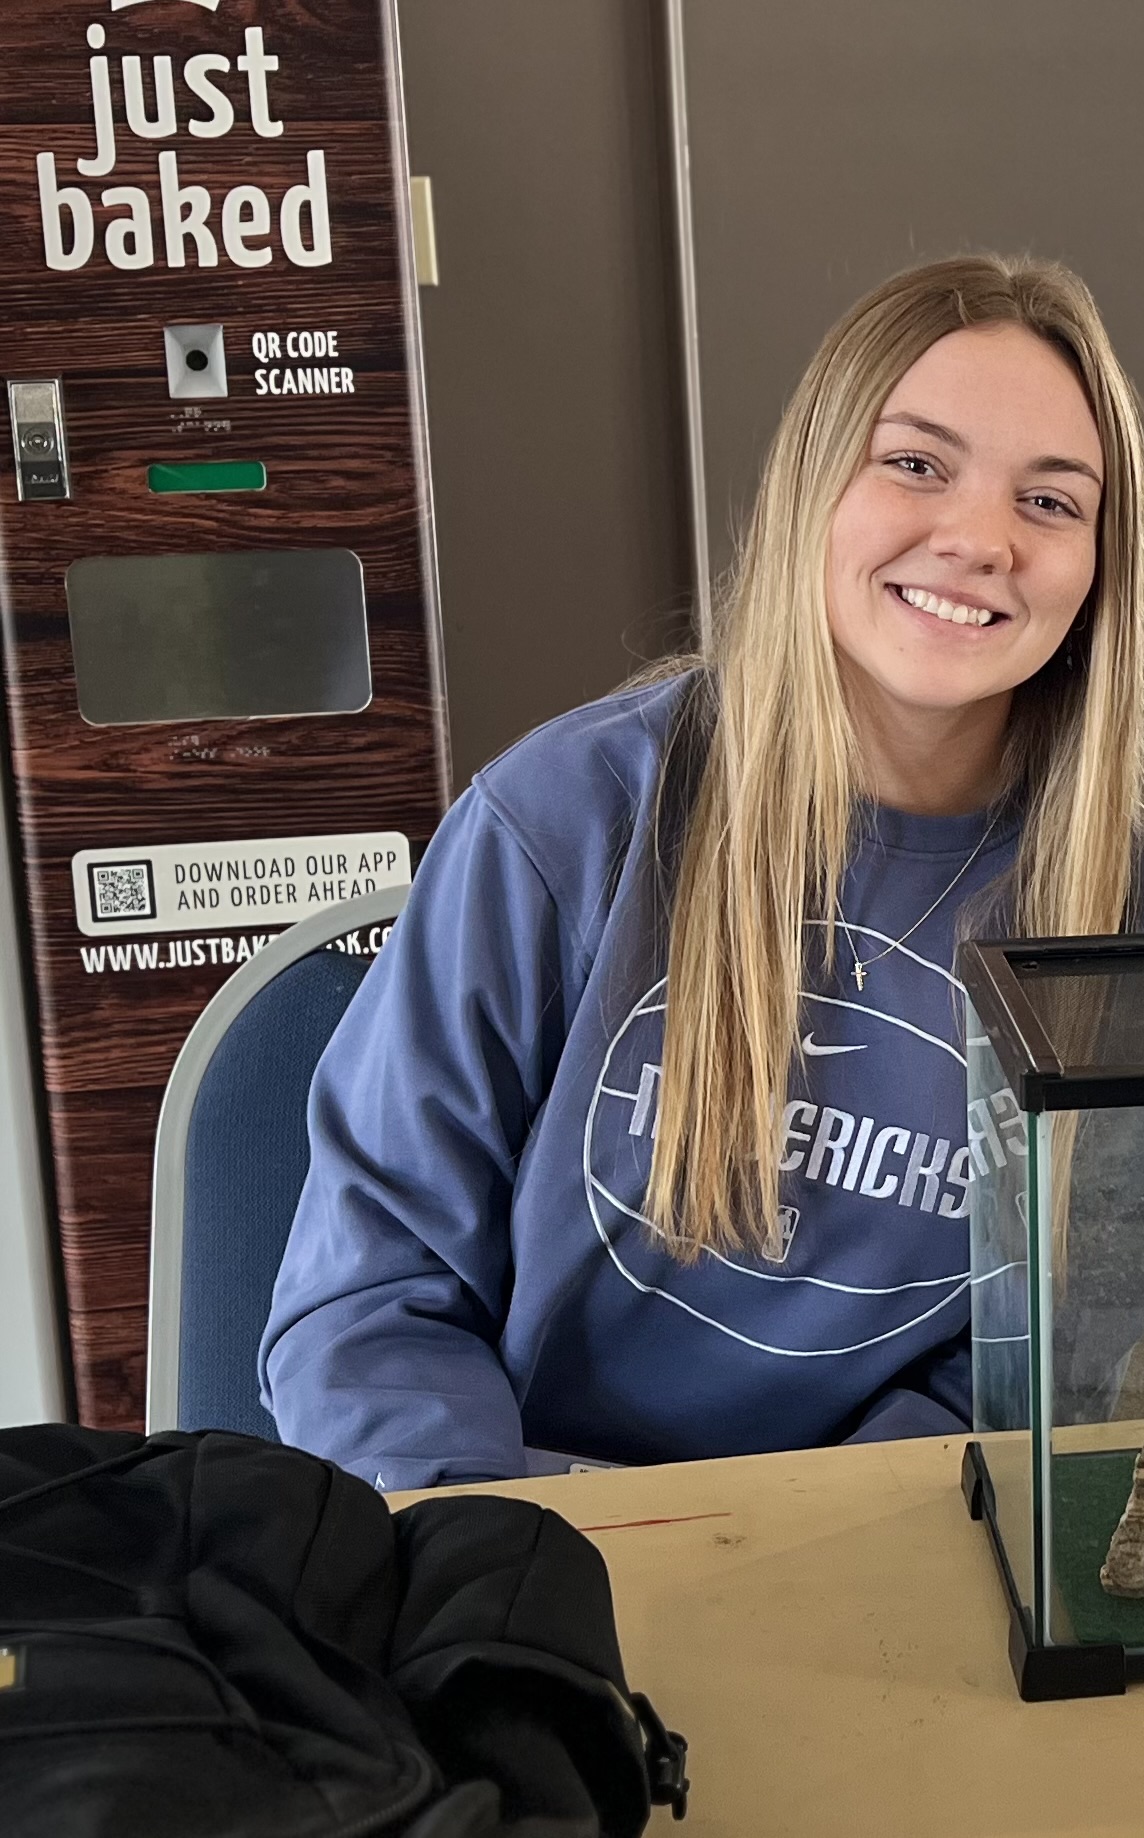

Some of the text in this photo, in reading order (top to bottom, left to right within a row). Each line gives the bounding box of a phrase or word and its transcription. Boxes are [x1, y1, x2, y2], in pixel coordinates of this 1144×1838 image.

[77, 24, 284, 177] just
[36, 150, 333, 271] baked
[252, 331, 339, 363] QR CODE
[254, 367, 355, 395] SCANNER
[174, 851, 397, 884] DOWNLOAD OUR APP
[177, 878, 376, 911] AND ORDER AHEAD
